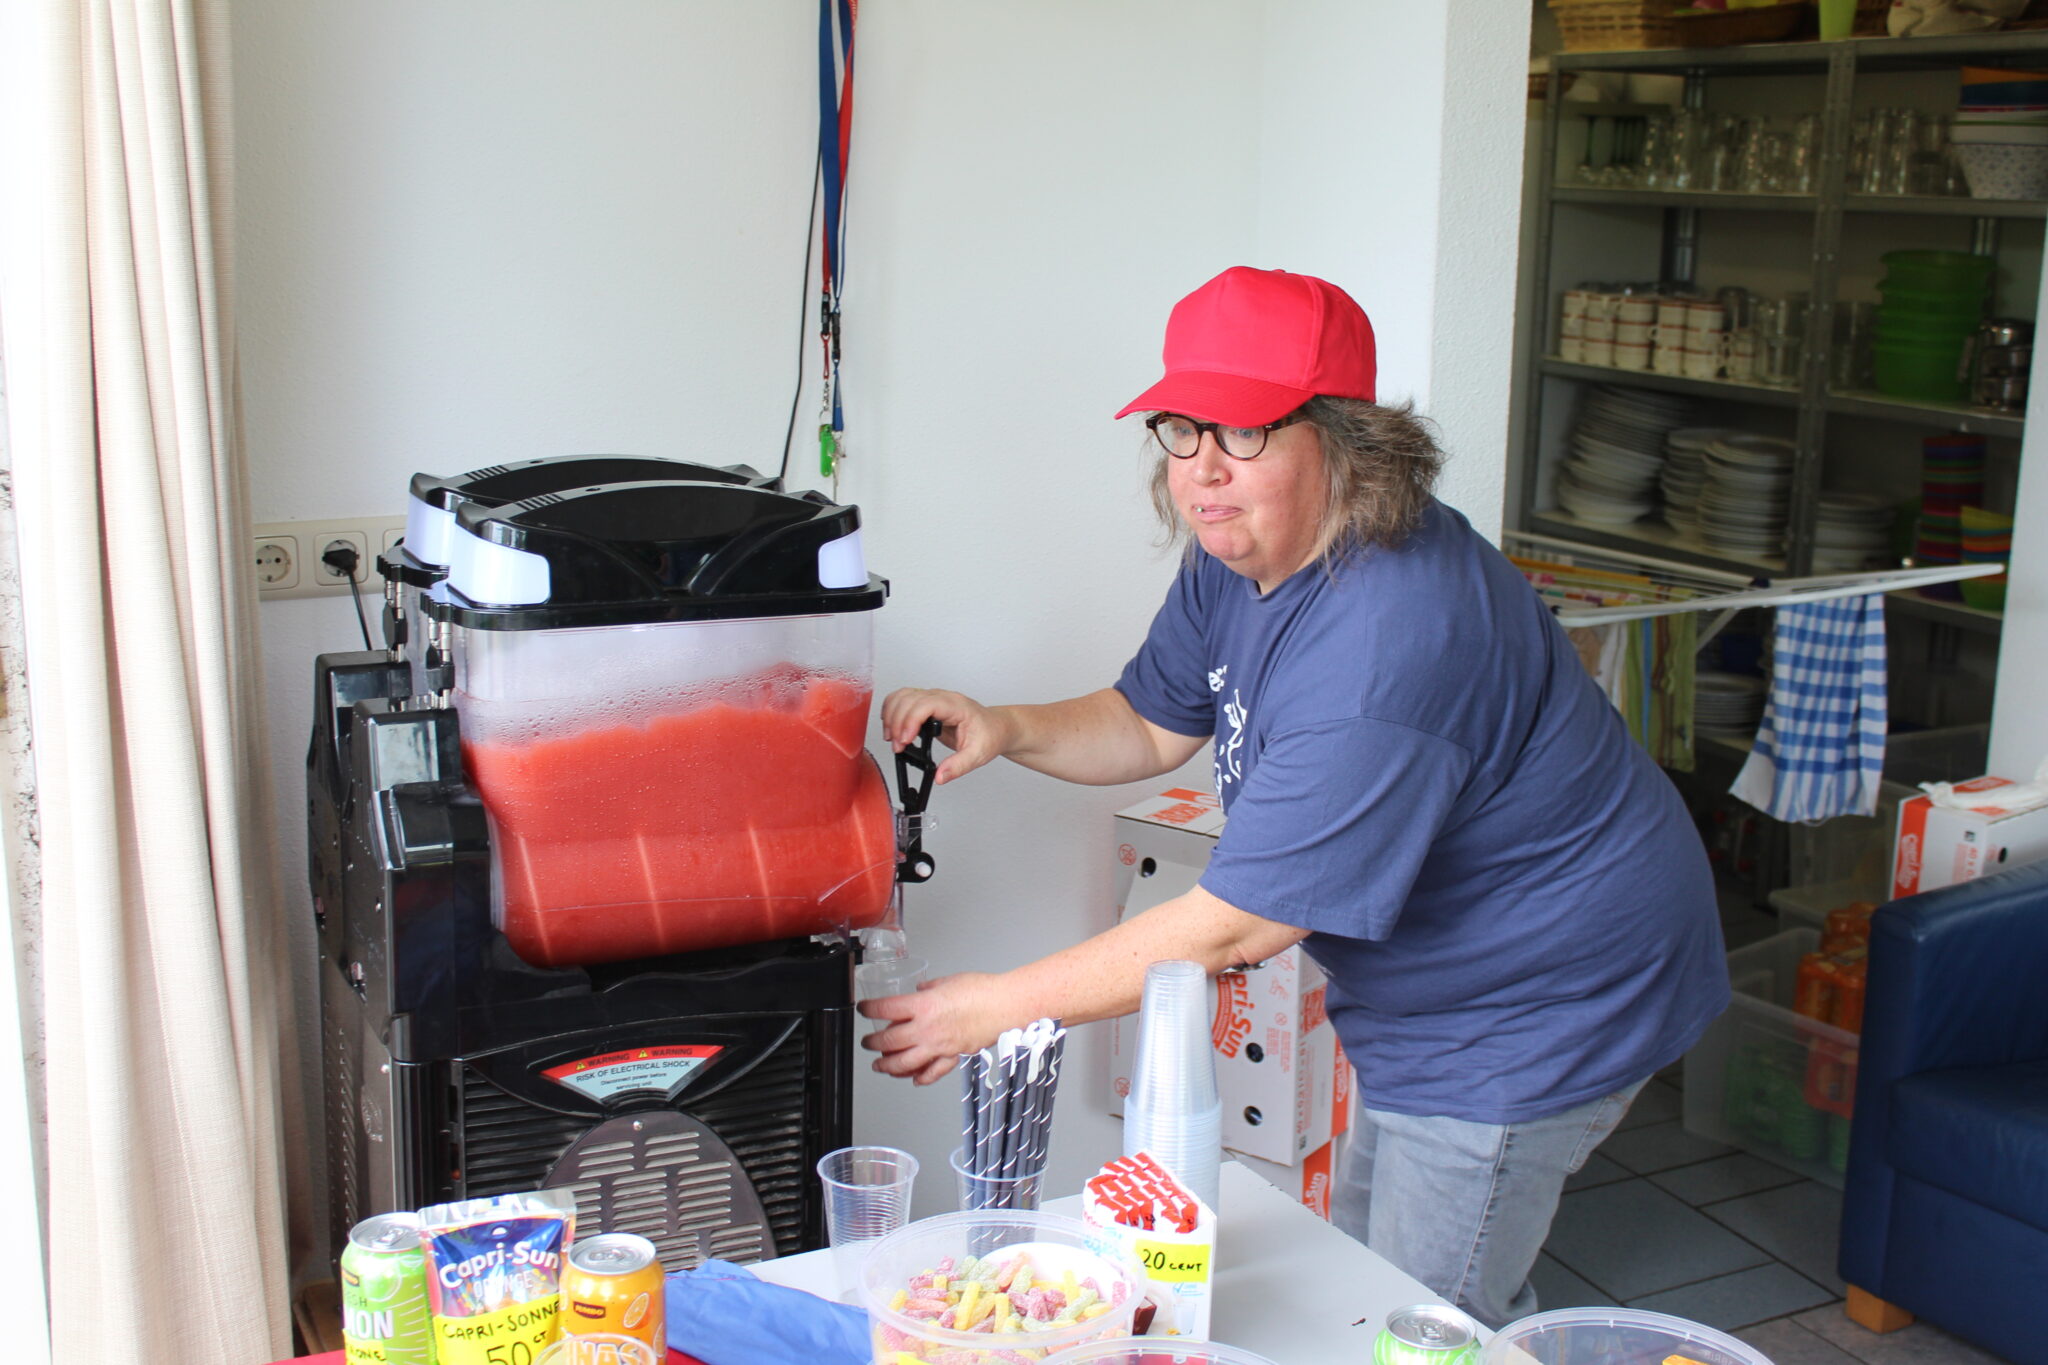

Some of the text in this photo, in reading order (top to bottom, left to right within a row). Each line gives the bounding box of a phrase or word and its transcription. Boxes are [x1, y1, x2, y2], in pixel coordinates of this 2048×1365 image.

[1221, 973, 1255, 1059] pri-Sun
[588, 1053, 630, 1066] WARNING
[651, 1048, 693, 1057] WARNING
[576, 1060, 691, 1082] RISK OF ELECTRICAL SHOCK
[600, 1077, 631, 1085] Disconnect
[438, 1241, 560, 1288] Capri-Sun
[1142, 1248, 1203, 1273] 20 CENT
[472, 1269, 534, 1298] ORNGE
[441, 1300, 560, 1341] CAPRI-SONNE
[486, 1341, 532, 1365] 50
